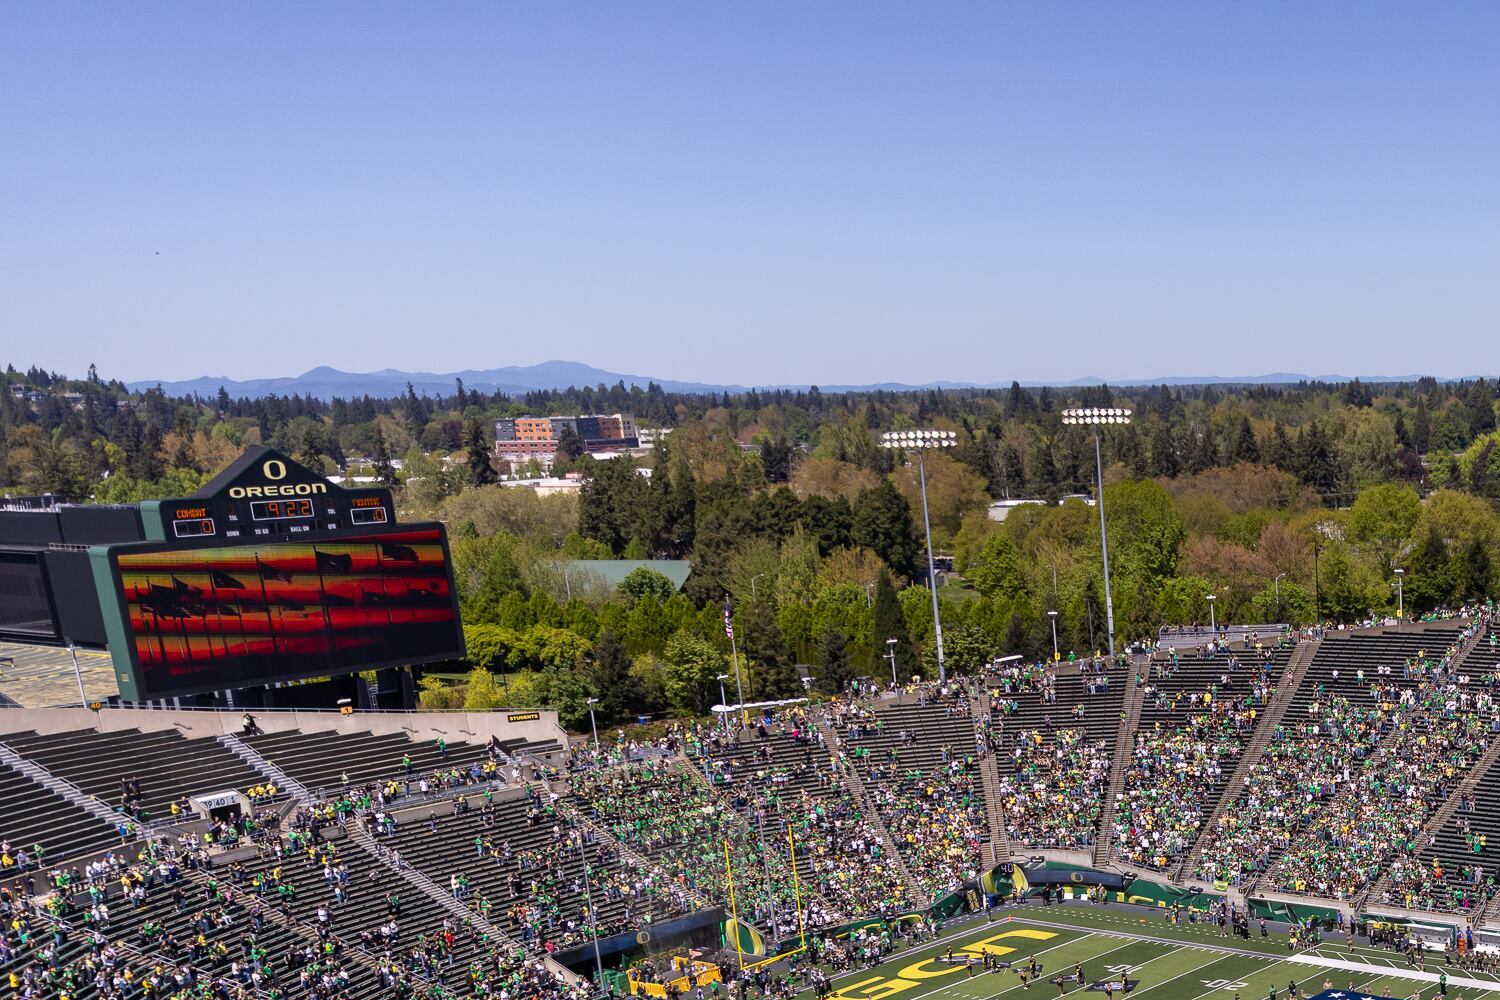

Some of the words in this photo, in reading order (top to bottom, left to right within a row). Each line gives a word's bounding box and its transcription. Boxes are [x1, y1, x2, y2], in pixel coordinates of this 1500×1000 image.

[263, 460, 287, 480] O
[229, 483, 327, 498] OREGON
[176, 508, 206, 519] COMBAT
[509, 713, 539, 721] STUDENTS
